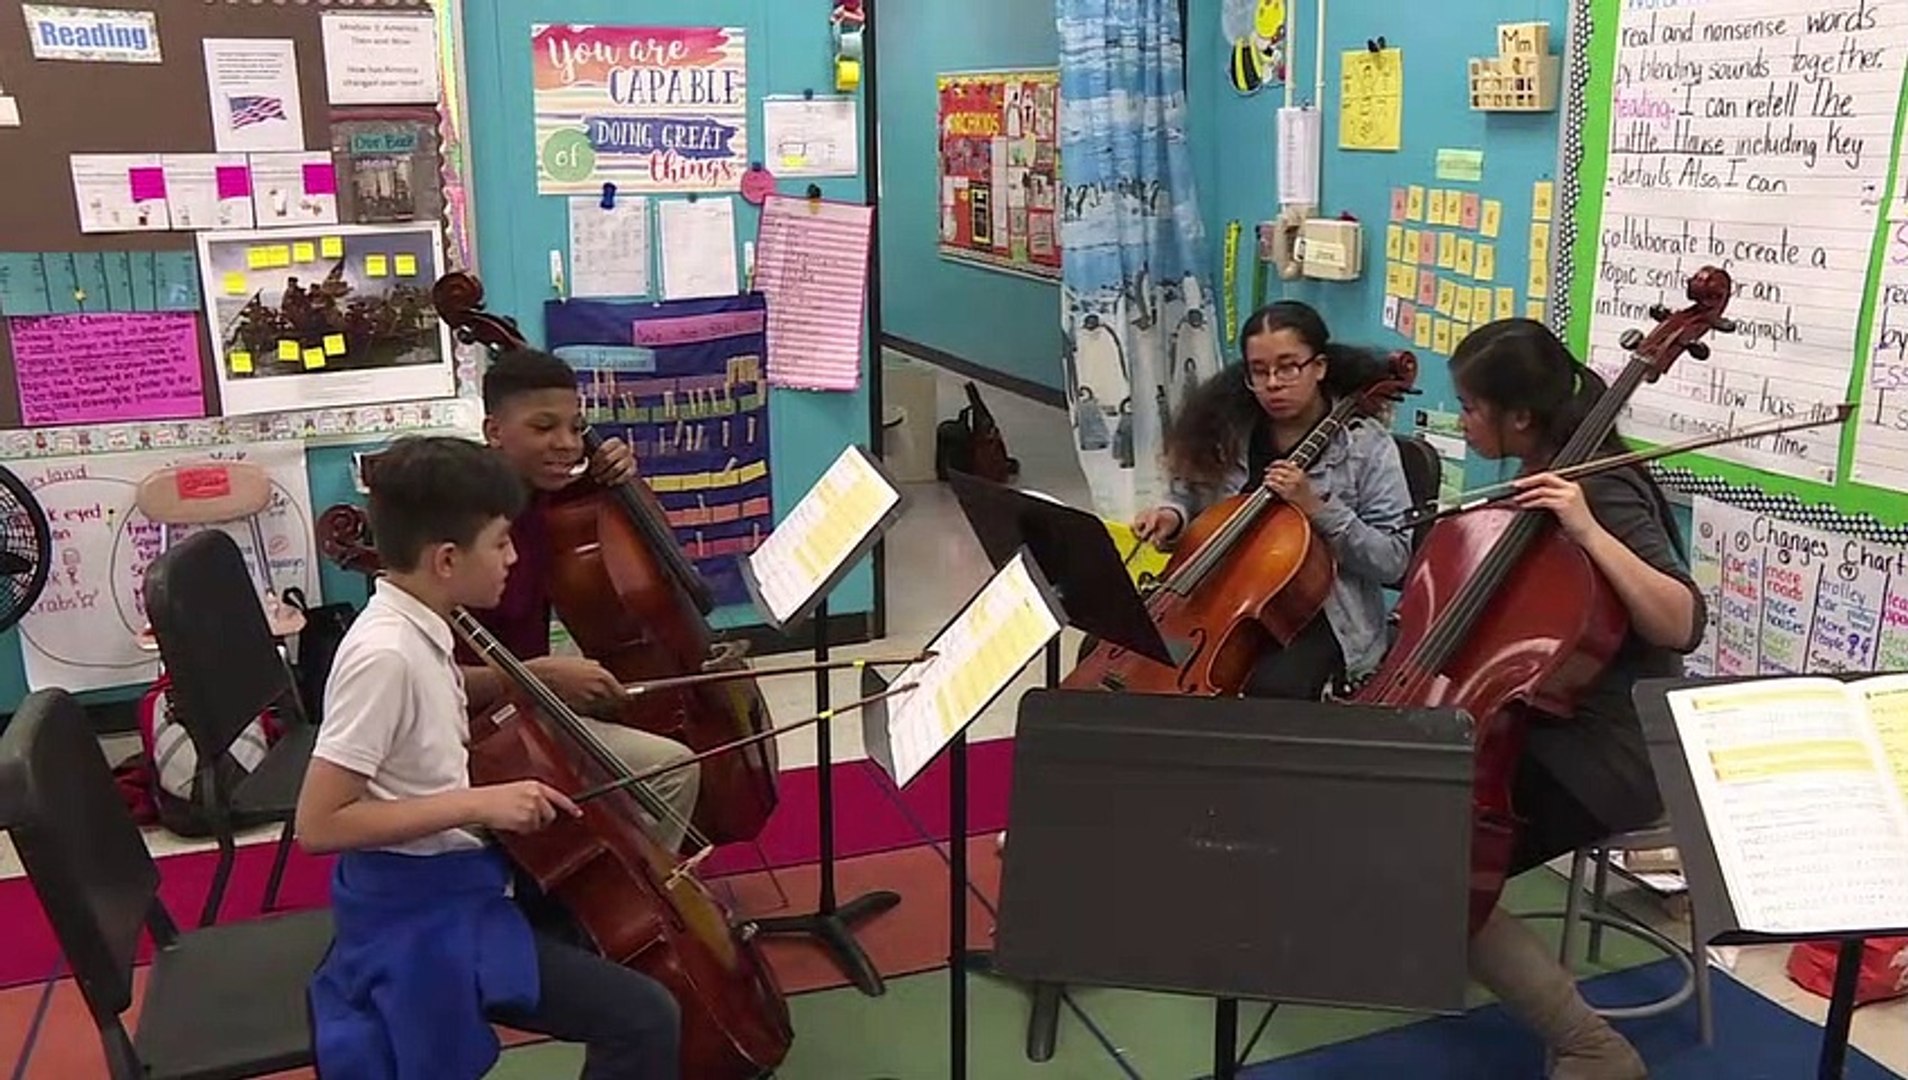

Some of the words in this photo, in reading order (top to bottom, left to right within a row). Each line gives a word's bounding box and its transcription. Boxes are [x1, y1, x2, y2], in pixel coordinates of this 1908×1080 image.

[38, 20, 148, 50] Reading
[1503, 29, 1533, 53] Mm
[1622, 11, 1657, 48] real
[1663, 11, 1695, 43] and
[1703, 19, 1786, 41] nonsense
[1807, 0, 1877, 34] words
[547, 36, 620, 84] You
[629, 38, 689, 66] are
[1640, 48, 1702, 85] blending
[1709, 46, 1770, 80] sounds
[609, 67, 741, 106] CAPABLE
[1706, 97, 1737, 118] can
[1747, 80, 1798, 118] retell
[1812, 77, 1856, 117] The
[597, 120, 653, 147] DOING
[661, 123, 725, 150] GREAT
[1611, 116, 1660, 154] Little
[1735, 121, 1818, 168] including
[555, 142, 580, 168] of
[1724, 158, 1747, 187] I
[1746, 174, 1788, 192] can
[1602, 215, 1698, 254] collaborate
[1708, 221, 1726, 256] to
[1733, 226, 1800, 264] create
[1811, 246, 1827, 269] a
[1753, 282, 1782, 304] an
[1709, 367, 1748, 409] How
[1759, 377, 1796, 417] has
[1752, 515, 1829, 566] Changes
[1843, 540, 1907, 576] Chart
[1766, 565, 1801, 584] more
